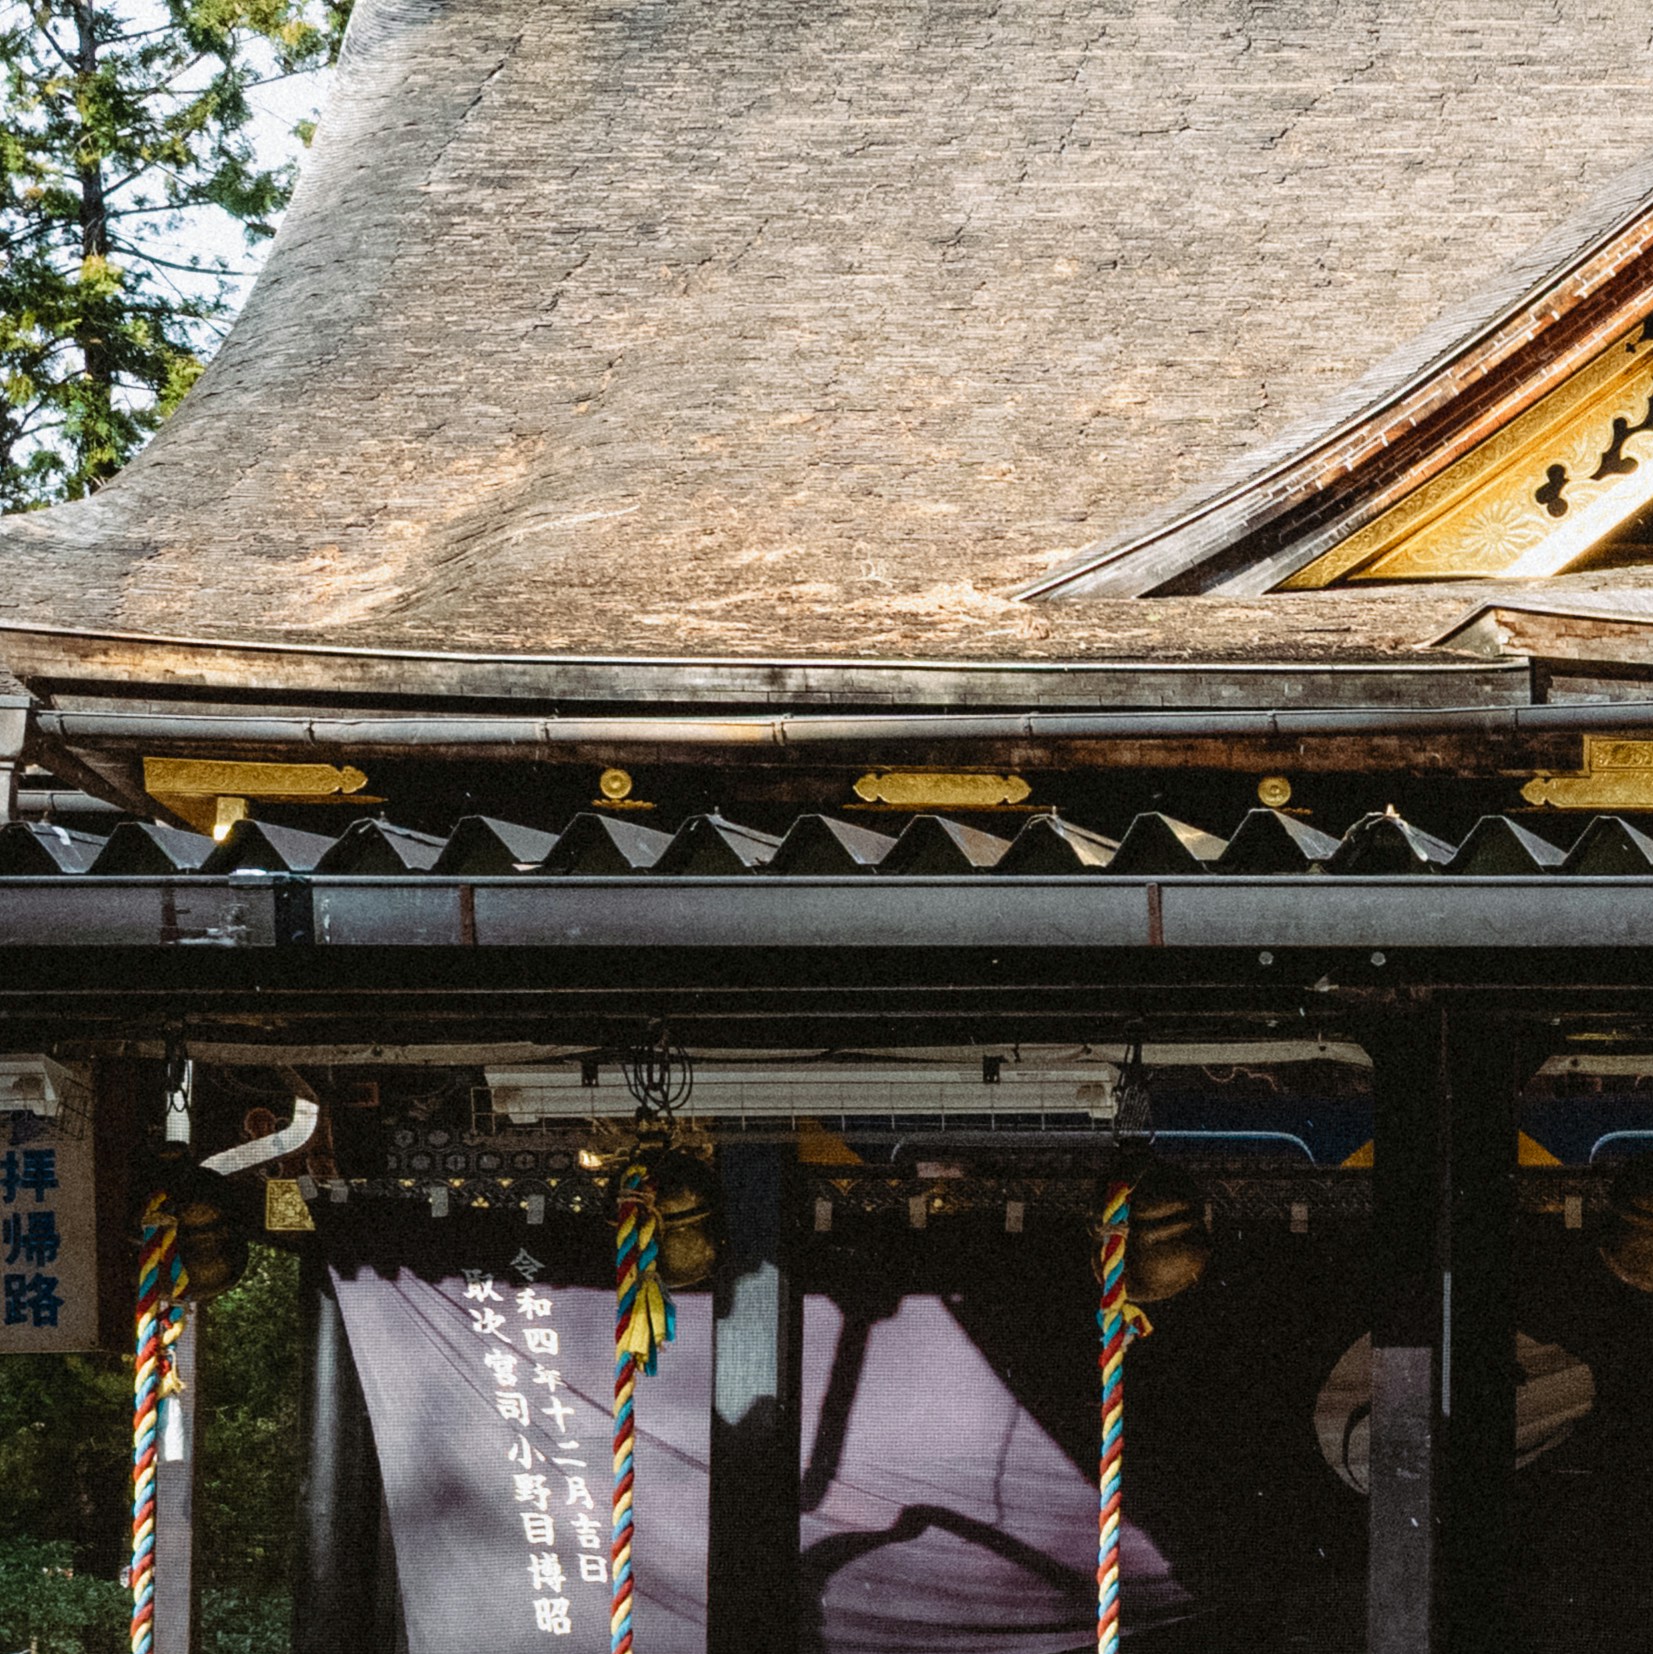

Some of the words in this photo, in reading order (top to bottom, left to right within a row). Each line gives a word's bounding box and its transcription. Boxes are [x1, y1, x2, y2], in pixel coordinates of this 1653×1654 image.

[0, 1110, 63, 1327] 拝帰路
[509, 1247, 608, 1584] 令和四年十二月吉日
